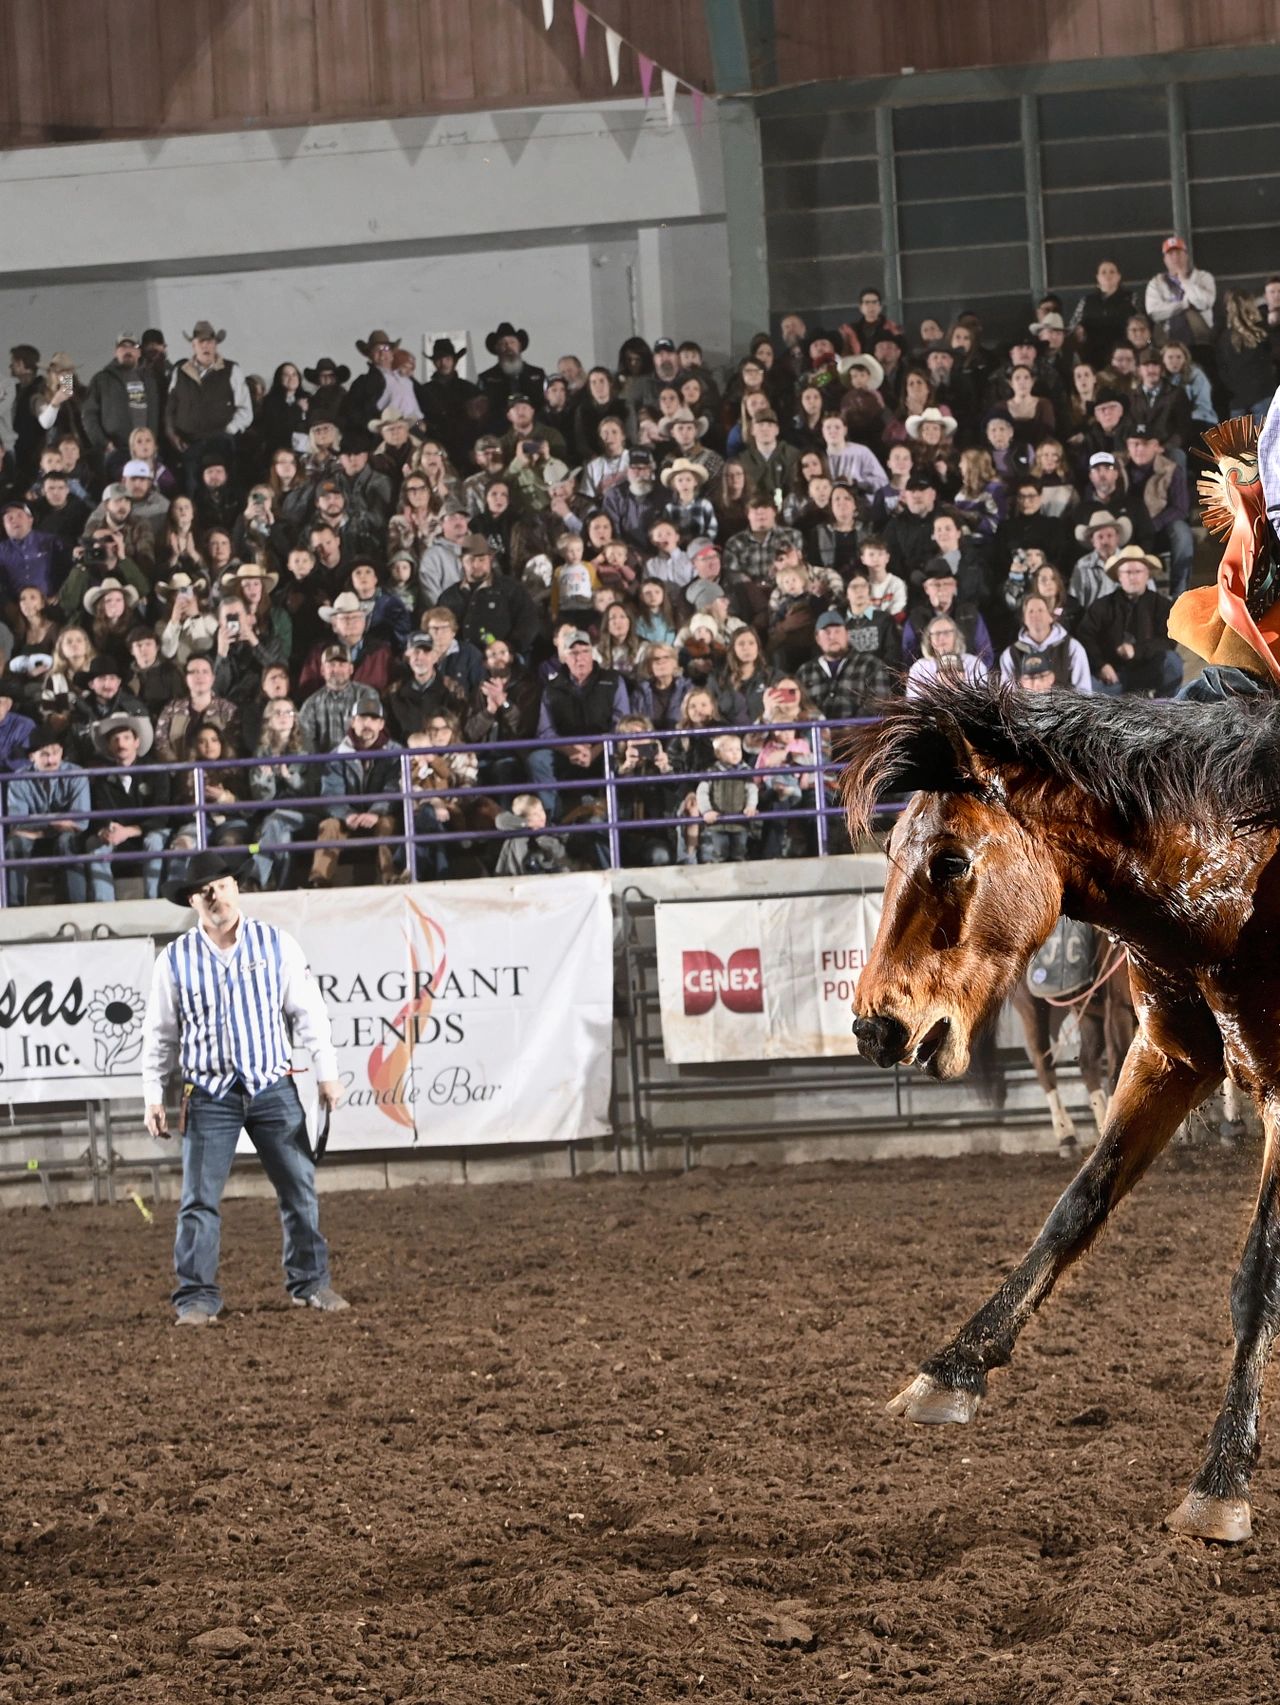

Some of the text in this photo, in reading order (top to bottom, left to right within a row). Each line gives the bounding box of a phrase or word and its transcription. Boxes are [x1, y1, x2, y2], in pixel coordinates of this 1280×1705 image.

[314, 966, 529, 1003] RAGRANT
[684, 967, 761, 993] CENEX
[292, 1013, 465, 1049] LENDS
[20, 1034, 80, 1068] Inc.
[428, 1066, 502, 1106] Bar
